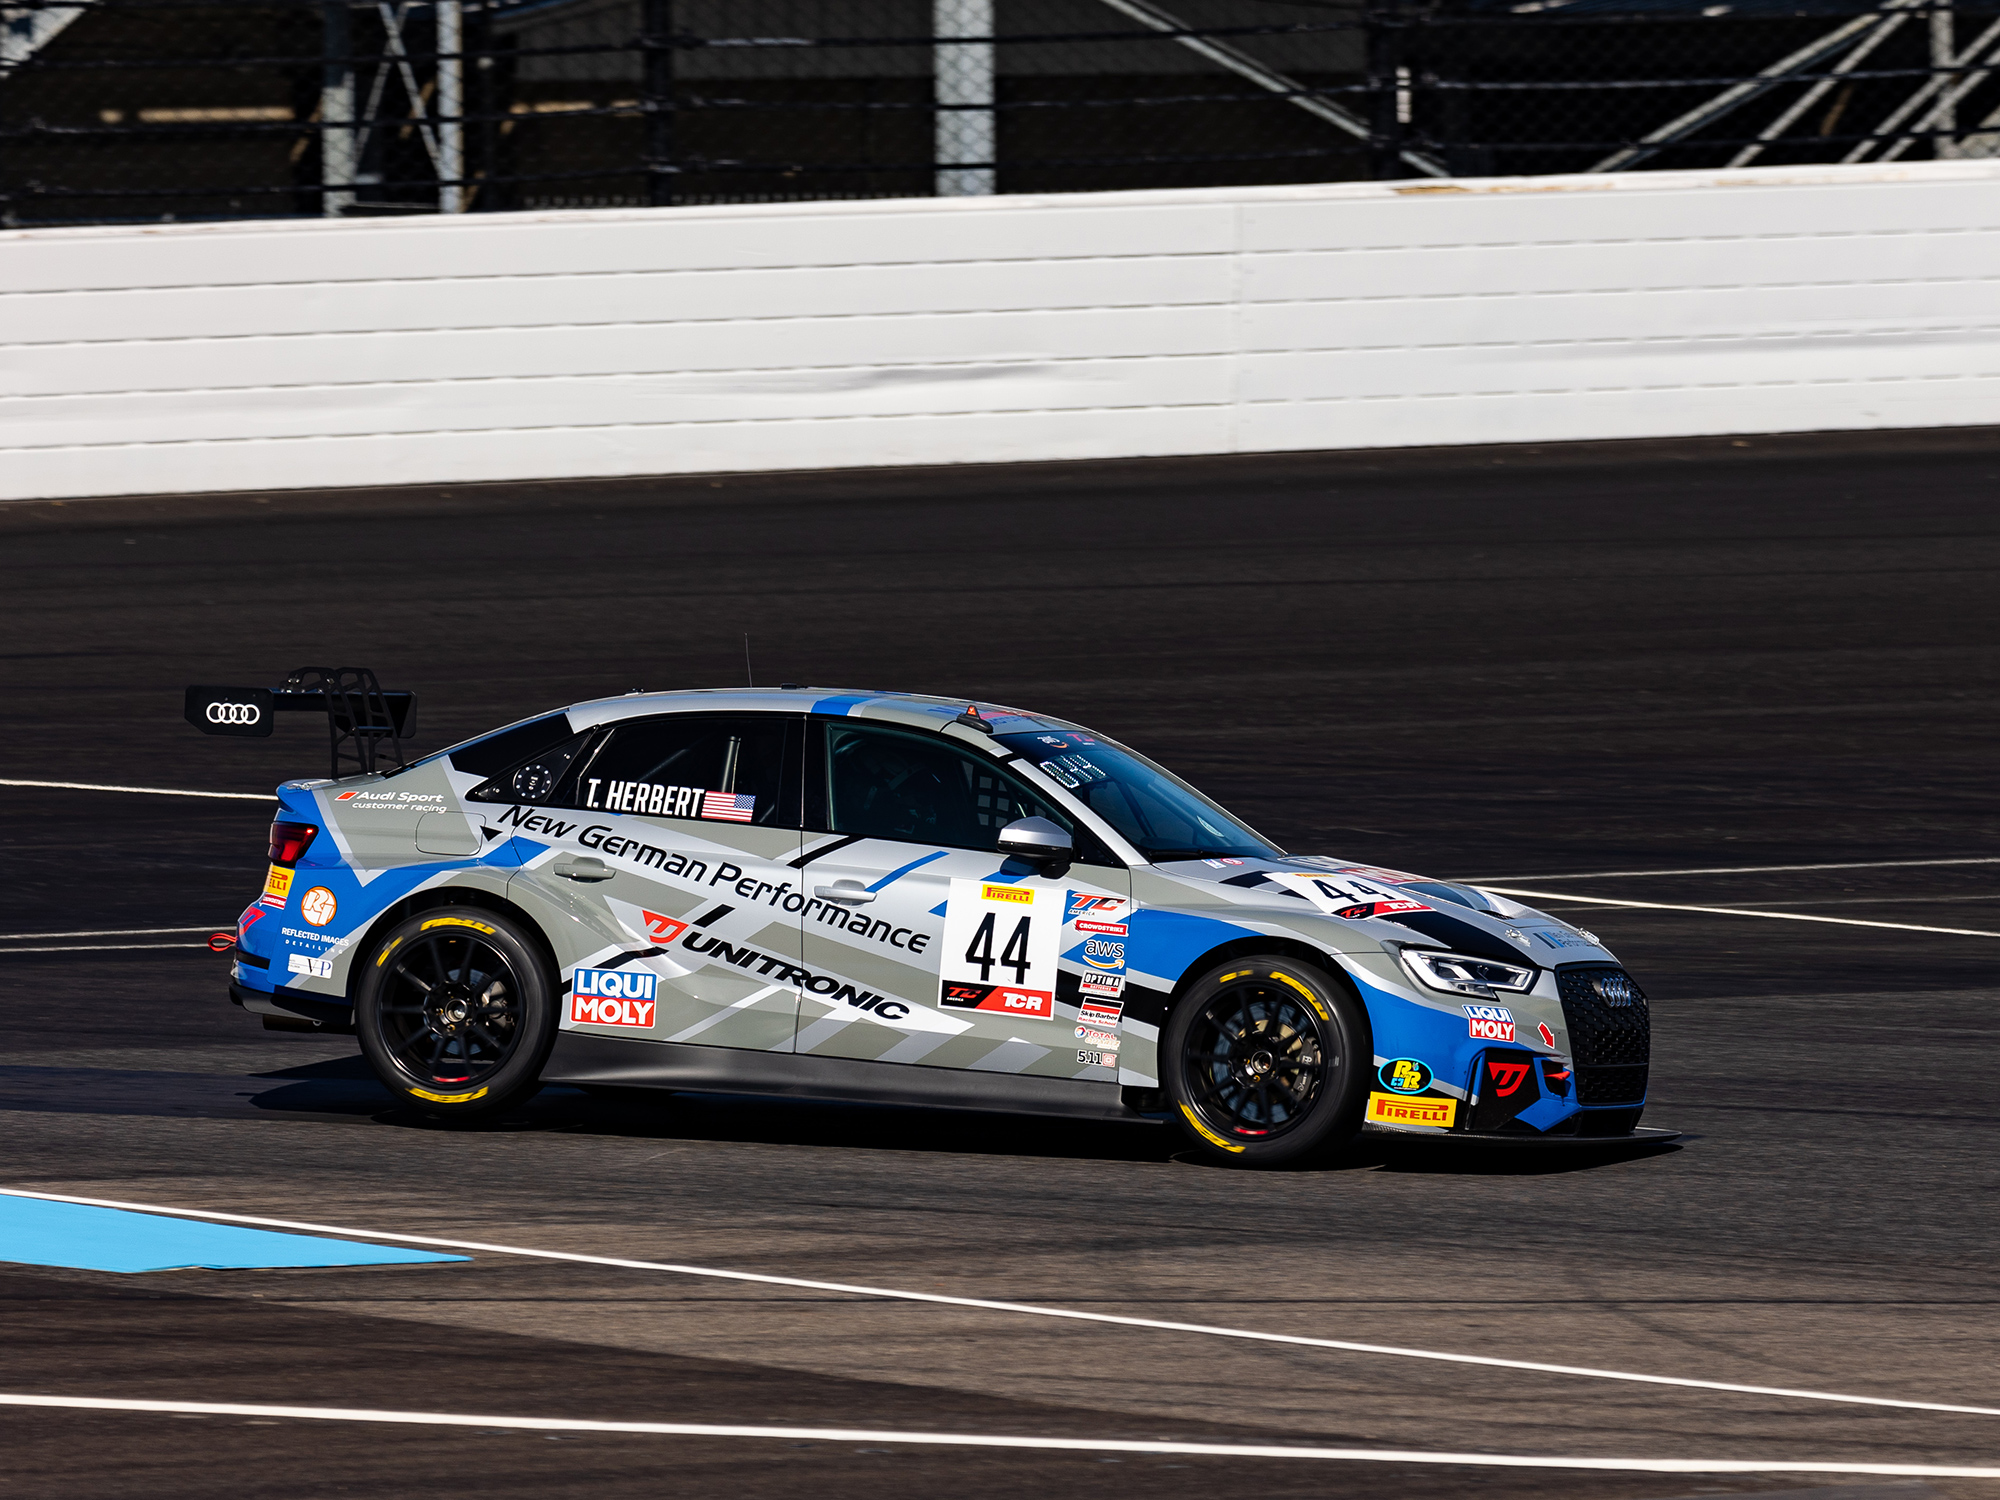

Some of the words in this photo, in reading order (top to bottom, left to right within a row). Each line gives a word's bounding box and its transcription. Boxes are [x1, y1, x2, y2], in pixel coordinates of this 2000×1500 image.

[356, 791, 397, 801] Audi
[397, 791, 445, 803] Sport
[586, 777, 602, 808] T.
[604, 780, 706, 818] HERBERT
[351, 802, 409, 811] customer
[410, 804, 448, 814] racing
[497, 805, 578, 839] New
[577, 824, 709, 884] German
[708, 861, 932, 955] Performance
[986, 886, 1031, 902] PIRELLI
[1311, 879, 1396, 904] 44
[1072, 892, 1127, 912] TC
[1383, 901, 1422, 911] TCR
[281, 927, 321, 941] REFLECTED
[320, 934, 350, 947] IMAGES
[1078, 922, 1125, 933] CROWDSTRIKE
[284, 939, 344, 954] DETAILING
[964, 911, 1032, 985] 44
[1085, 939, 1124, 958] aws
[576, 970, 654, 998] LIQUI
[681, 931, 910, 1020] UNITRONIC
[1085, 973, 1120, 987] OPTIMA
[575, 996, 655, 1025] MOLY
[1002, 991, 1044, 1011] TCR
[1078, 1016, 1097, 1024] Racing
[1080, 1010, 1095, 1018] Skip
[1095, 1012, 1118, 1021] Barber
[1465, 1006, 1513, 1022] LIQUI
[1087, 1029, 1117, 1040] TOTAL
[1471, 1019, 1514, 1041] MOLY
[1078, 1050, 1102, 1065] 5.11
[1376, 1098, 1449, 1121] PIRELLI
